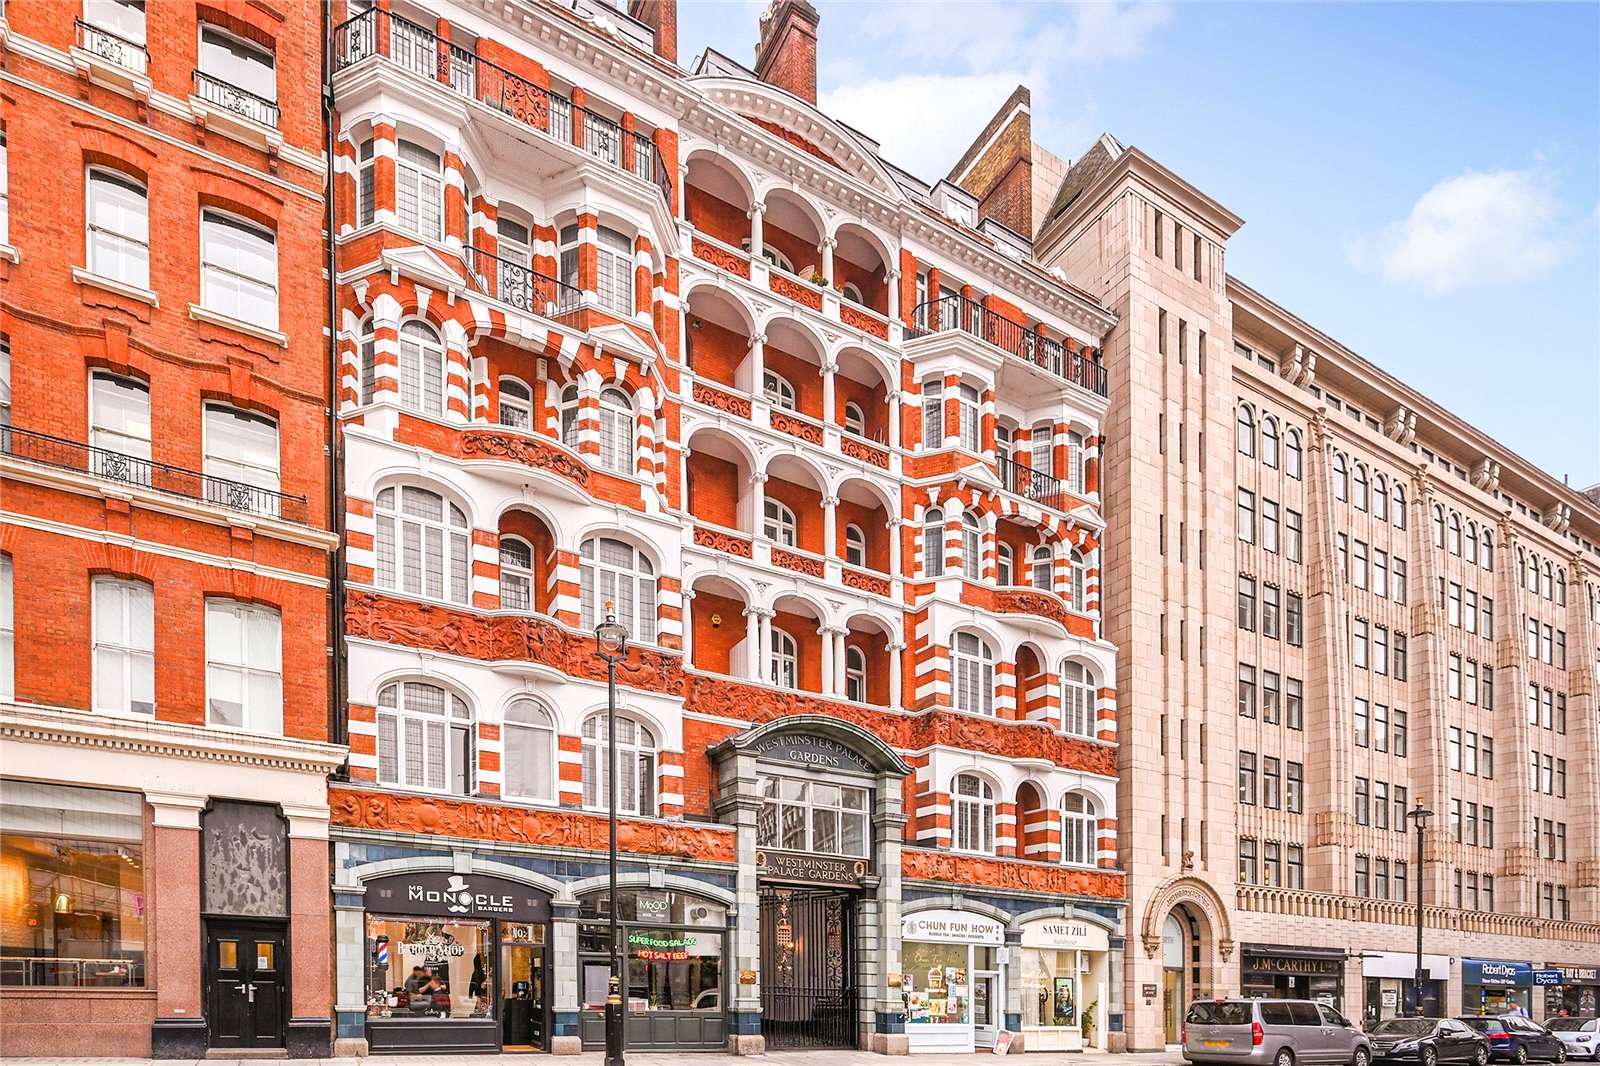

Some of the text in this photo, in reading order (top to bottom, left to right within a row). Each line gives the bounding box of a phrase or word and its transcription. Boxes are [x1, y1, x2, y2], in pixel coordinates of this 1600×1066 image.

[755, 735, 871, 771] WESTMINSTER PALACE
[789, 750, 840, 767] GARDENS
[775, 856, 847, 873] WESTMINSTER
[767, 865, 854, 882] PALACE GARDENS
[918, 920, 946, 931] CHUN
[949, 922, 968, 932] FUN
[971, 924, 994, 934] HOW
[1042, 924, 1070, 936] SAMET
[628, 935, 697, 947] SUPER FOOD SALADS
[638, 950, 689, 960] HOT SALT BEEF
[1482, 963, 1516, 977] Robert Dyas
